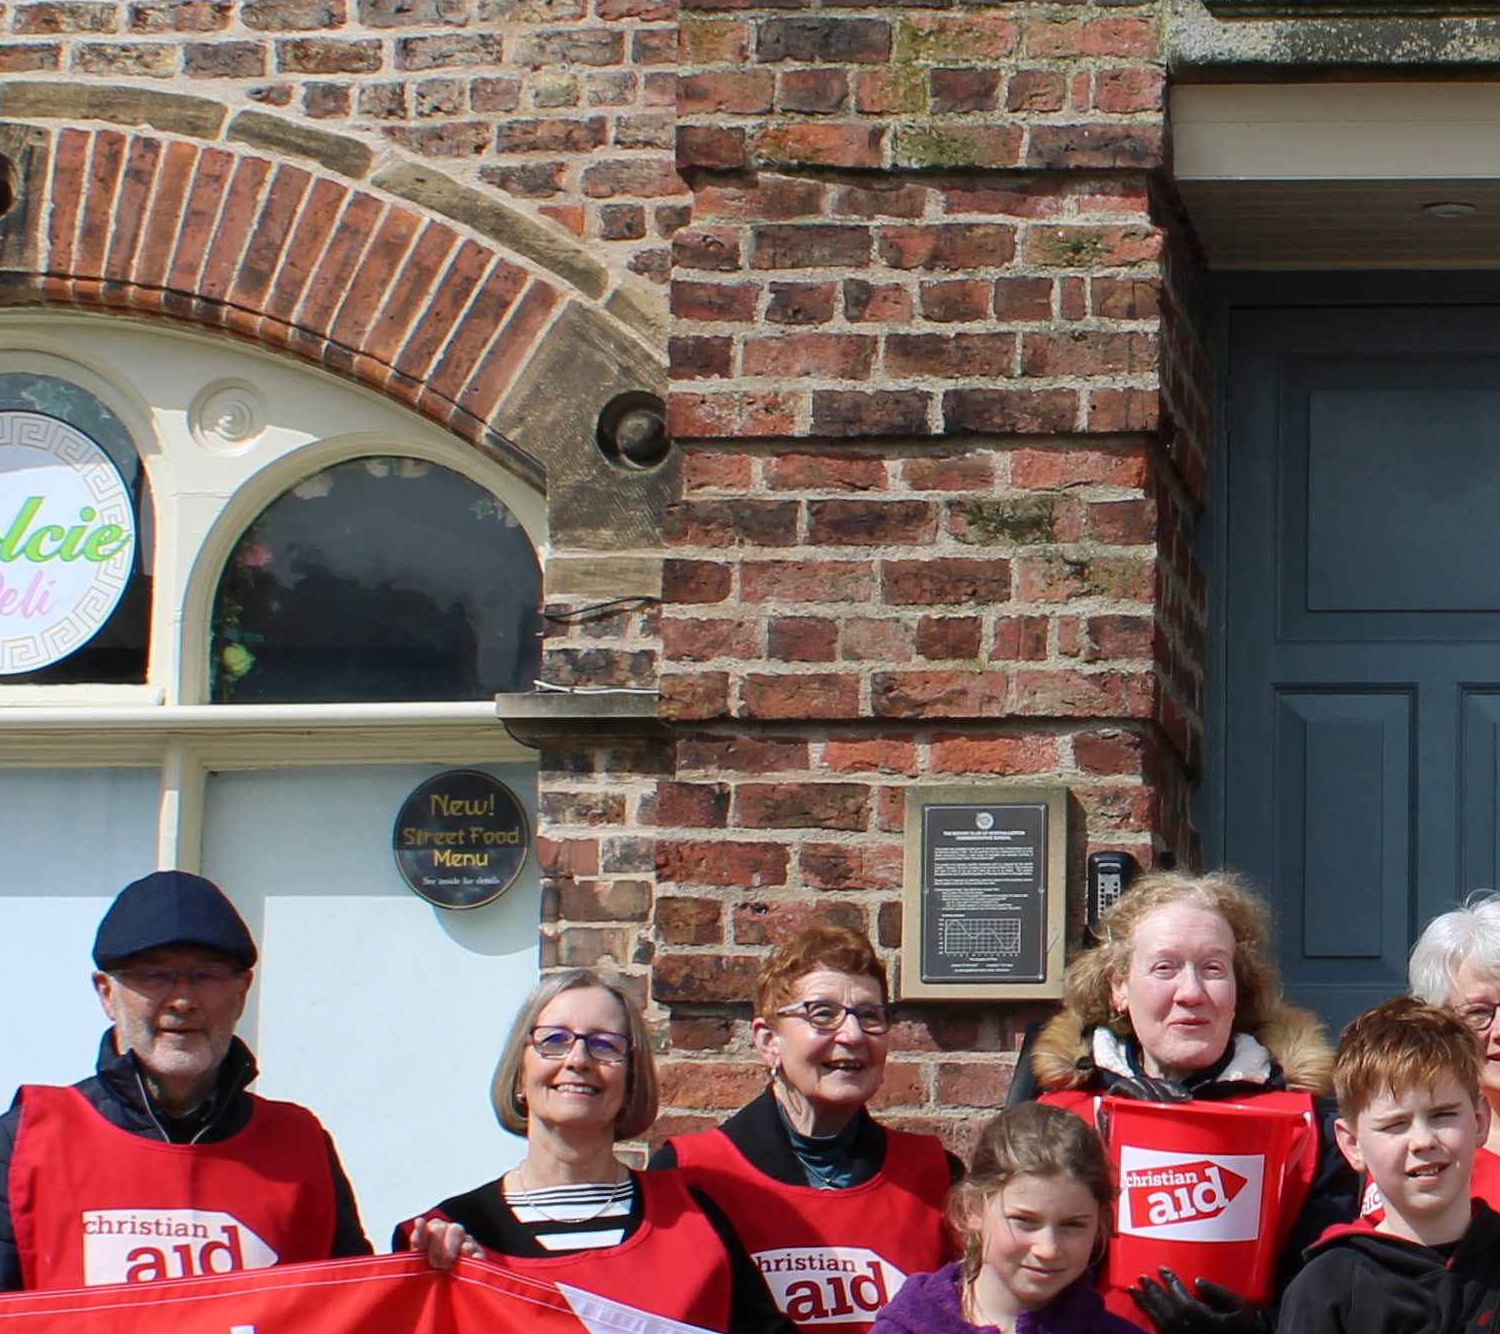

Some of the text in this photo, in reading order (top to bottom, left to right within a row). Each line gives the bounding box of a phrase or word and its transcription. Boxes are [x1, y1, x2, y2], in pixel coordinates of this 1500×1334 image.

[429, 794, 495, 817] New!
[403, 826, 520, 846] Street Food
[432, 849, 489, 868] Menu
[1125, 1168, 1199, 1188] christian
[1148, 1167, 1230, 1225] aid
[83, 1215, 210, 1239] christian
[126, 1224, 245, 1284] aid
[756, 1253, 857, 1273] hristian
[785, 1261, 889, 1322] aid
